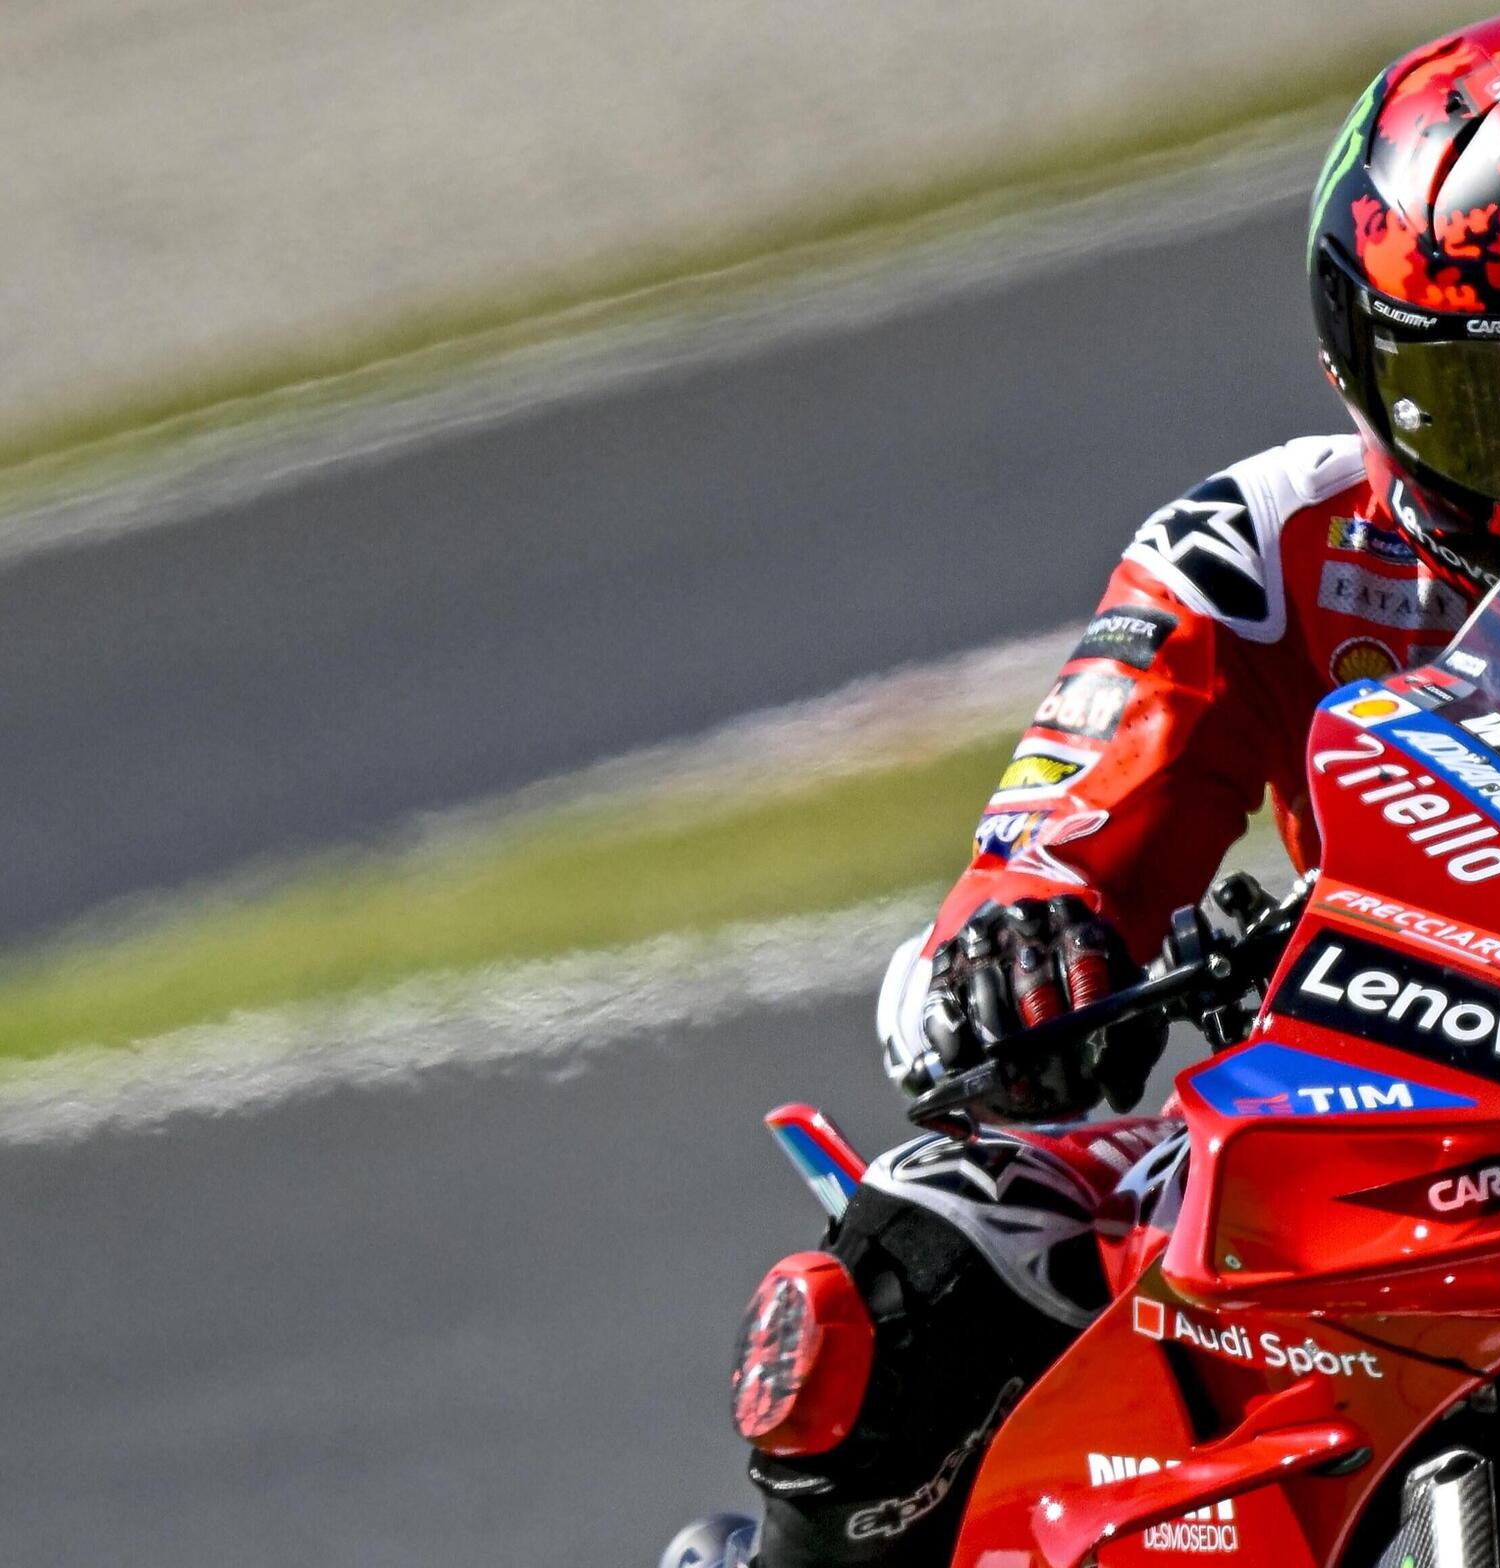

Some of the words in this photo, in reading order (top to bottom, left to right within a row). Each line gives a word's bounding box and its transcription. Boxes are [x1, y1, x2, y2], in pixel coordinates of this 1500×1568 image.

[1373, 300, 1438, 328] SUOMY
[1297, 1083, 1414, 1114] TIM
[1173, 1311, 1254, 1359] Audi
[1259, 1331, 1384, 1378] Sport
